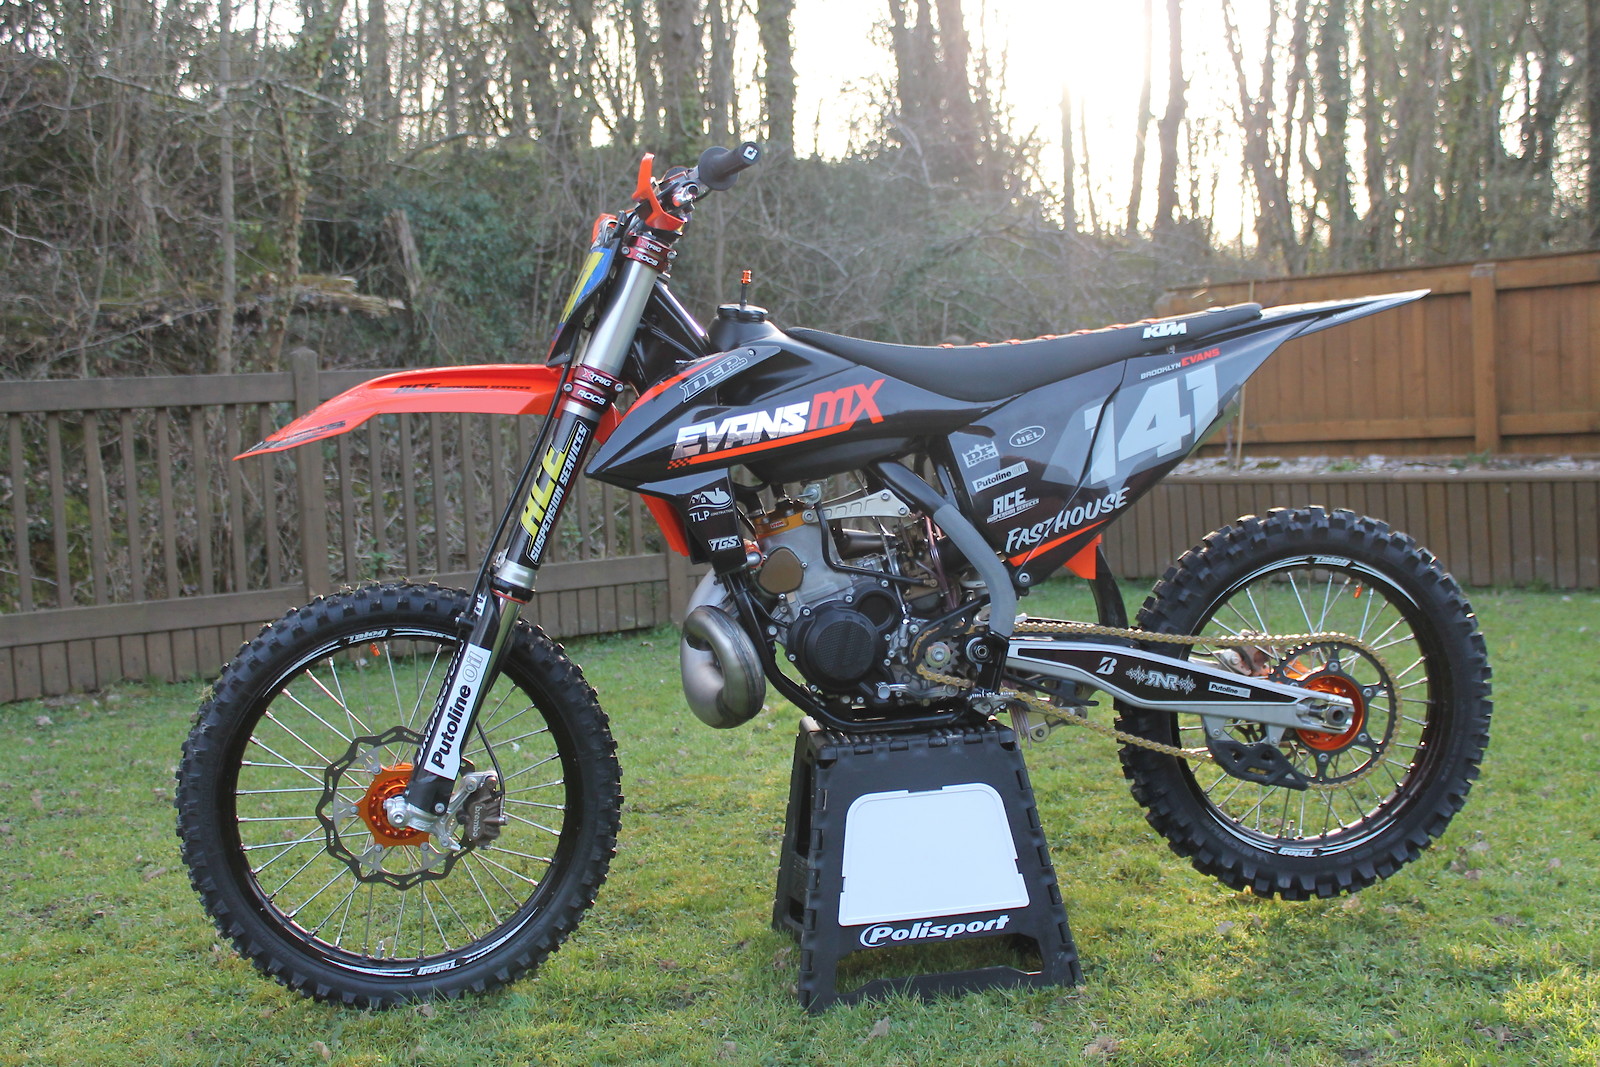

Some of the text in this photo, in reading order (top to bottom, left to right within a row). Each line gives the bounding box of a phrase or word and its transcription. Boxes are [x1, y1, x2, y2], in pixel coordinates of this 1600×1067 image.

[1142, 321, 1187, 339] KTM
[581, 367, 612, 387] XTRIG
[685, 355, 737, 396] DEP
[1140, 348, 1221, 380] BROOKLYN EVANS
[577, 389, 606, 406] ROCS
[671, 401, 810, 460] EVANS
[1016, 431, 1041, 445] HEL
[1084, 364, 1220, 485] 141
[530, 423, 588, 564] SUSPENSION SERVICES
[976, 470, 1012, 489] Putoline
[689, 510, 710, 522] TLP
[993, 487, 1027, 516] ACE
[1005, 487, 1130, 553] FASTHOUSE
[710, 535, 739, 552] TGS
[1210, 683, 1239, 694] Putoline
[430, 685, 472, 770] Putoline
[461, 650, 484, 683] Oil
[472, 805, 483, 838] brembo
[867, 914, 1010, 944] Polisport
